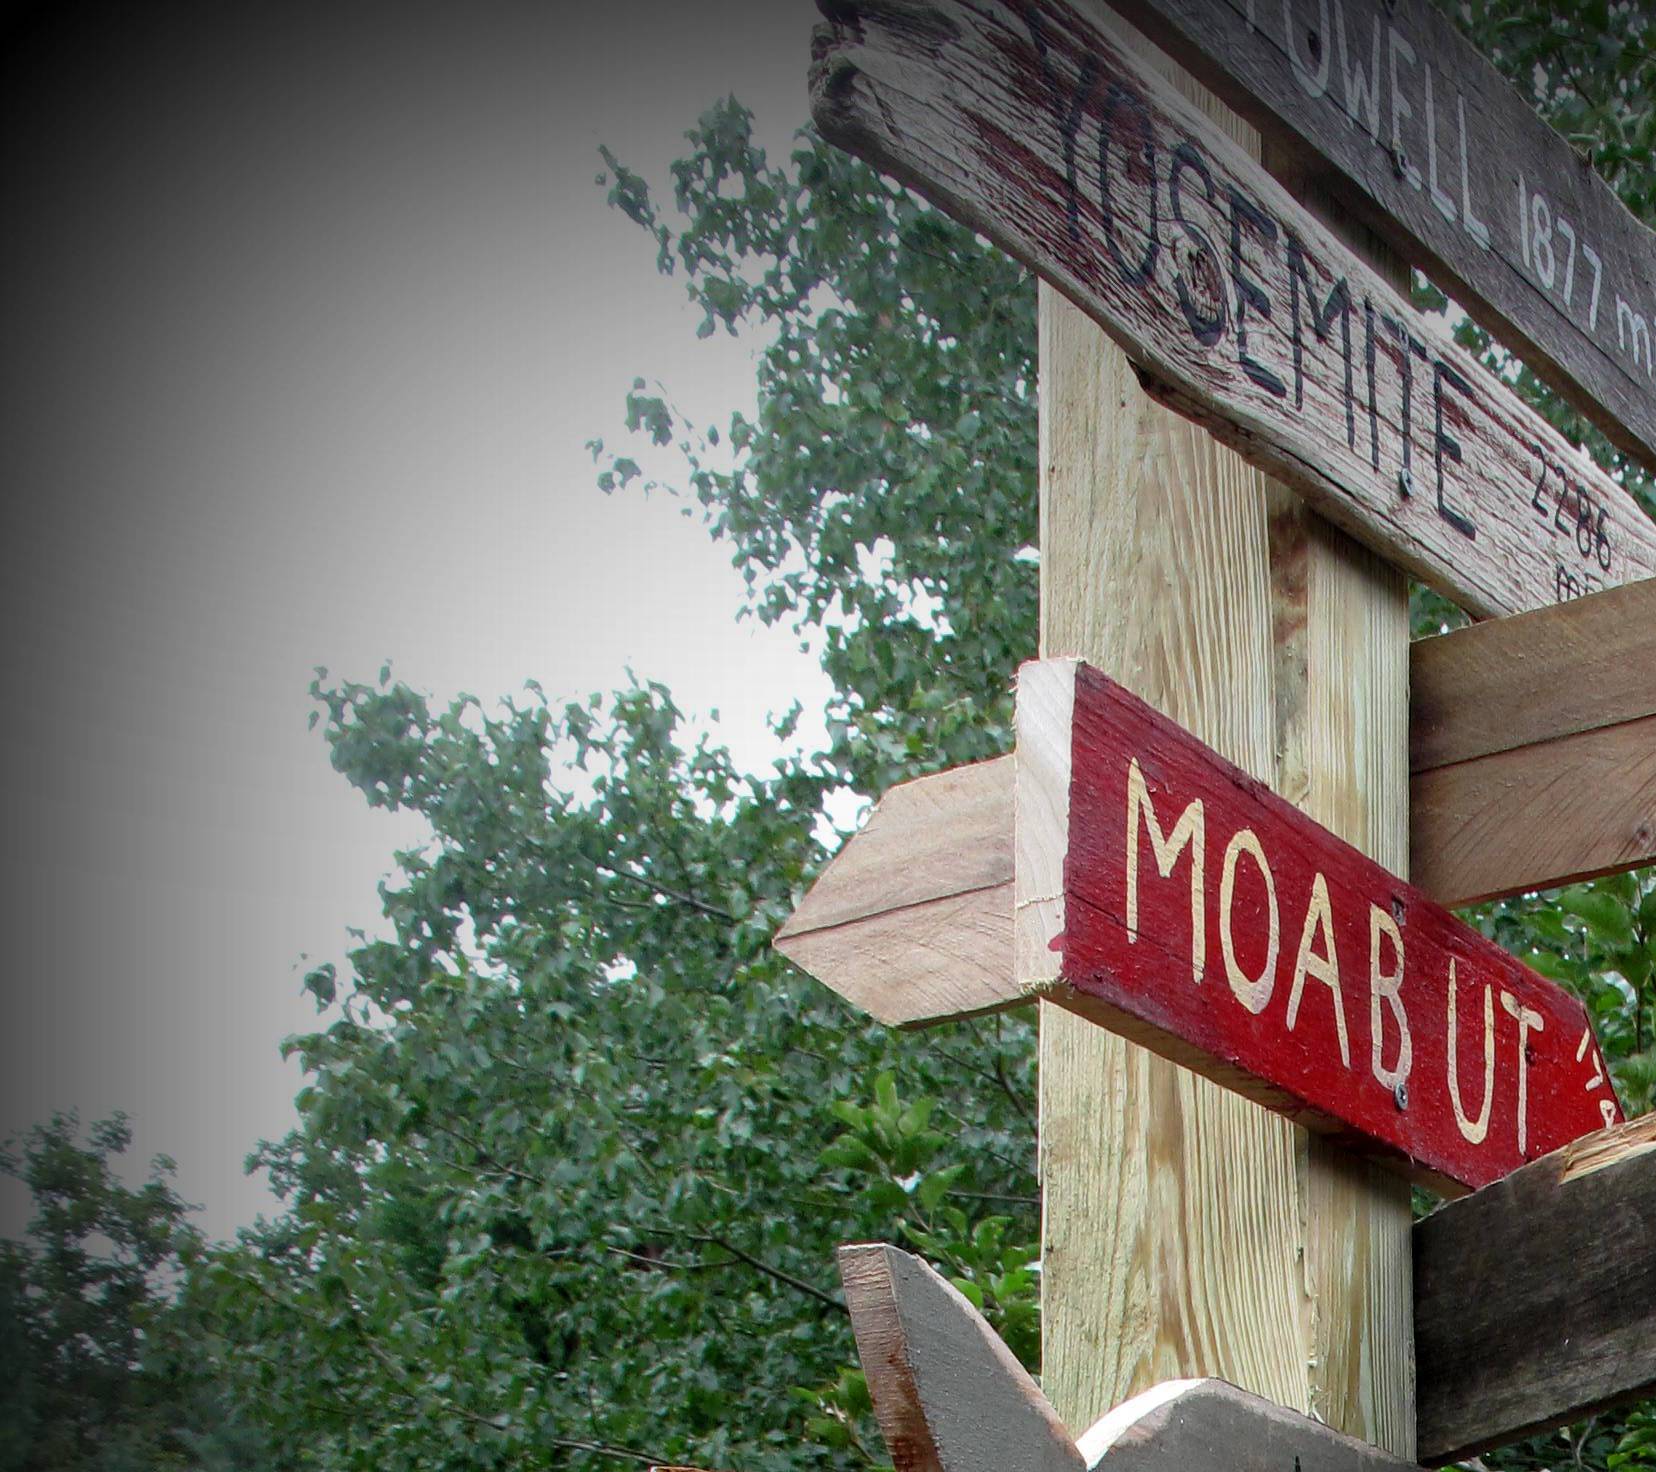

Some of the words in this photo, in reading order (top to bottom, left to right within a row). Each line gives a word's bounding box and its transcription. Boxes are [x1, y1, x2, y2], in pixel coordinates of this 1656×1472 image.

[1020, 4, 1477, 541] YOSEMITE
[1246, 0, 1490, 250] OWELL
[1518, 172, 1602, 332] 1877
[1531, 445, 1612, 572] 2286
[1125, 756, 1413, 1091] MOAB
[1446, 956, 1545, 1157] UT
